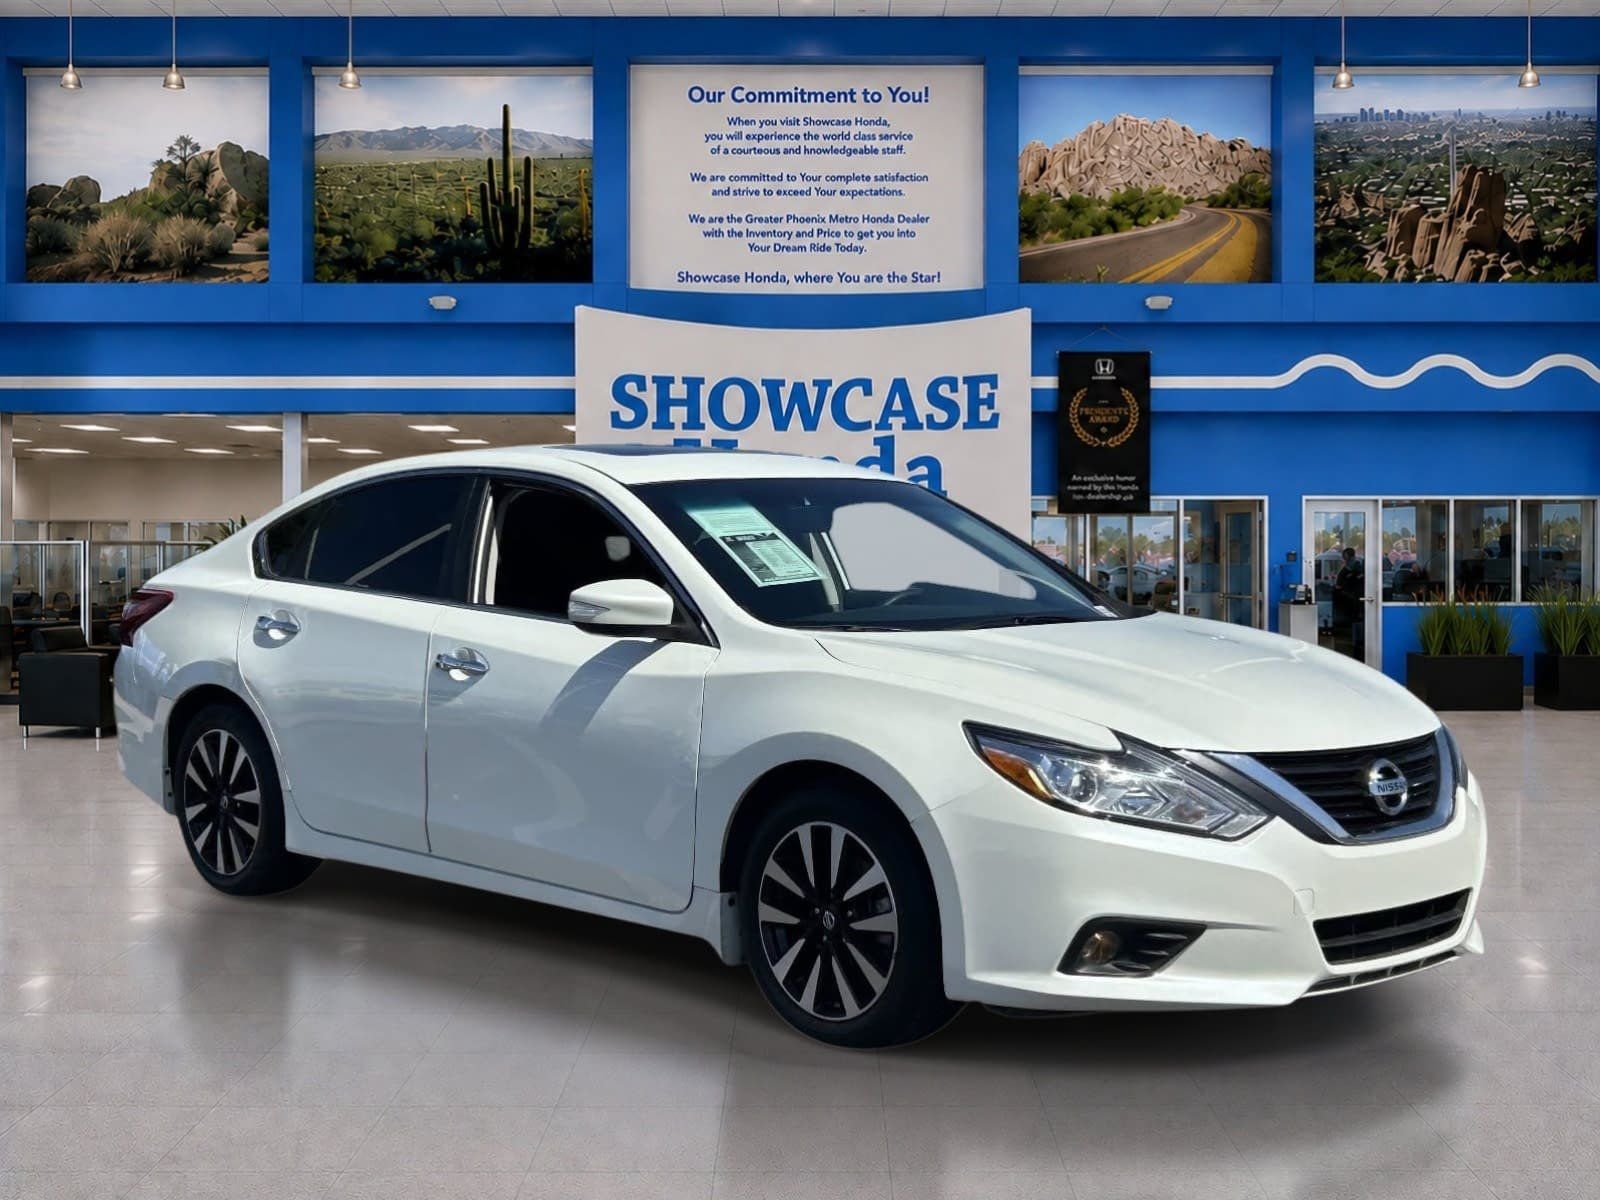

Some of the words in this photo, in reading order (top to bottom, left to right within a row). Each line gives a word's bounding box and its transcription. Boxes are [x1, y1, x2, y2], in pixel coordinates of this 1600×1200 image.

[688, 85, 726, 104] Our
[730, 86, 857, 104] Commitment
[861, 88, 883, 104] to
[886, 86, 929, 104] You!
[726, 116, 756, 126] When
[758, 119, 778, 130] you
[779, 116, 801, 127] visit
[802, 116, 852, 127] Showcase
[854, 116, 891, 128] Honda,
[704, 133, 724, 143] you
[725, 130, 743, 141] will
[745, 131, 801, 144] experience
[803, 130, 820, 141] the
[822, 130, 851, 141] world
[853, 131, 877, 141] class
[878, 131, 914, 141] service
[710, 144, 721, 155] of
[722, 147, 730, 155] a
[731, 147, 781, 156] courteous
[782, 145, 802, 155] and
[881, 144, 906, 155] staff.
[690, 172, 707, 182] We
[709, 174, 726, 182] are
[728, 172, 784, 182] committed
[786, 173, 797, 182] to
[799, 172, 822, 182] Your
[824, 172, 872, 185] complete
[874, 172, 929, 182] satisfaction
[711, 186, 731, 197] and
[732, 186, 760, 197] strive
[762, 188, 774, 197] to
[775, 186, 812, 197] exceed
[814, 186, 838, 197] Your
[839, 186, 906, 200] expectations.
[688, 214, 706, 224] We
[708, 216, 724, 224] are
[726, 213, 743, 224] the
[744, 214, 784, 224] Greater
[786, 214, 826, 224] Phoenix
[828, 214, 860, 224] Metro
[862, 214, 895, 224] Honda
[897, 213, 930, 224] Dealer
[702, 227, 725, 238] with
[727, 227, 744, 238] the
[746, 228, 794, 241] Inventory
[795, 227, 814, 238] and
[816, 228, 842, 238] Price
[844, 230, 855, 238] to
[856, 229, 874, 241] get
[876, 230, 895, 240] you
[896, 228, 916, 238] into
[748, 242, 771, 253] Your
[773, 242, 807, 253] Dream
[809, 242, 832, 253] Ride
[834, 242, 867, 255] Today.
[677, 270, 741, 284] Showcase
[744, 271, 790, 286] Honda,
[794, 271, 834, 284] where
[837, 272, 860, 284] You
[864, 274, 884, 284] are
[886, 271, 908, 284] the
[911, 271, 941, 284] Star!
[611, 374, 1000, 432] SHOWCASE
